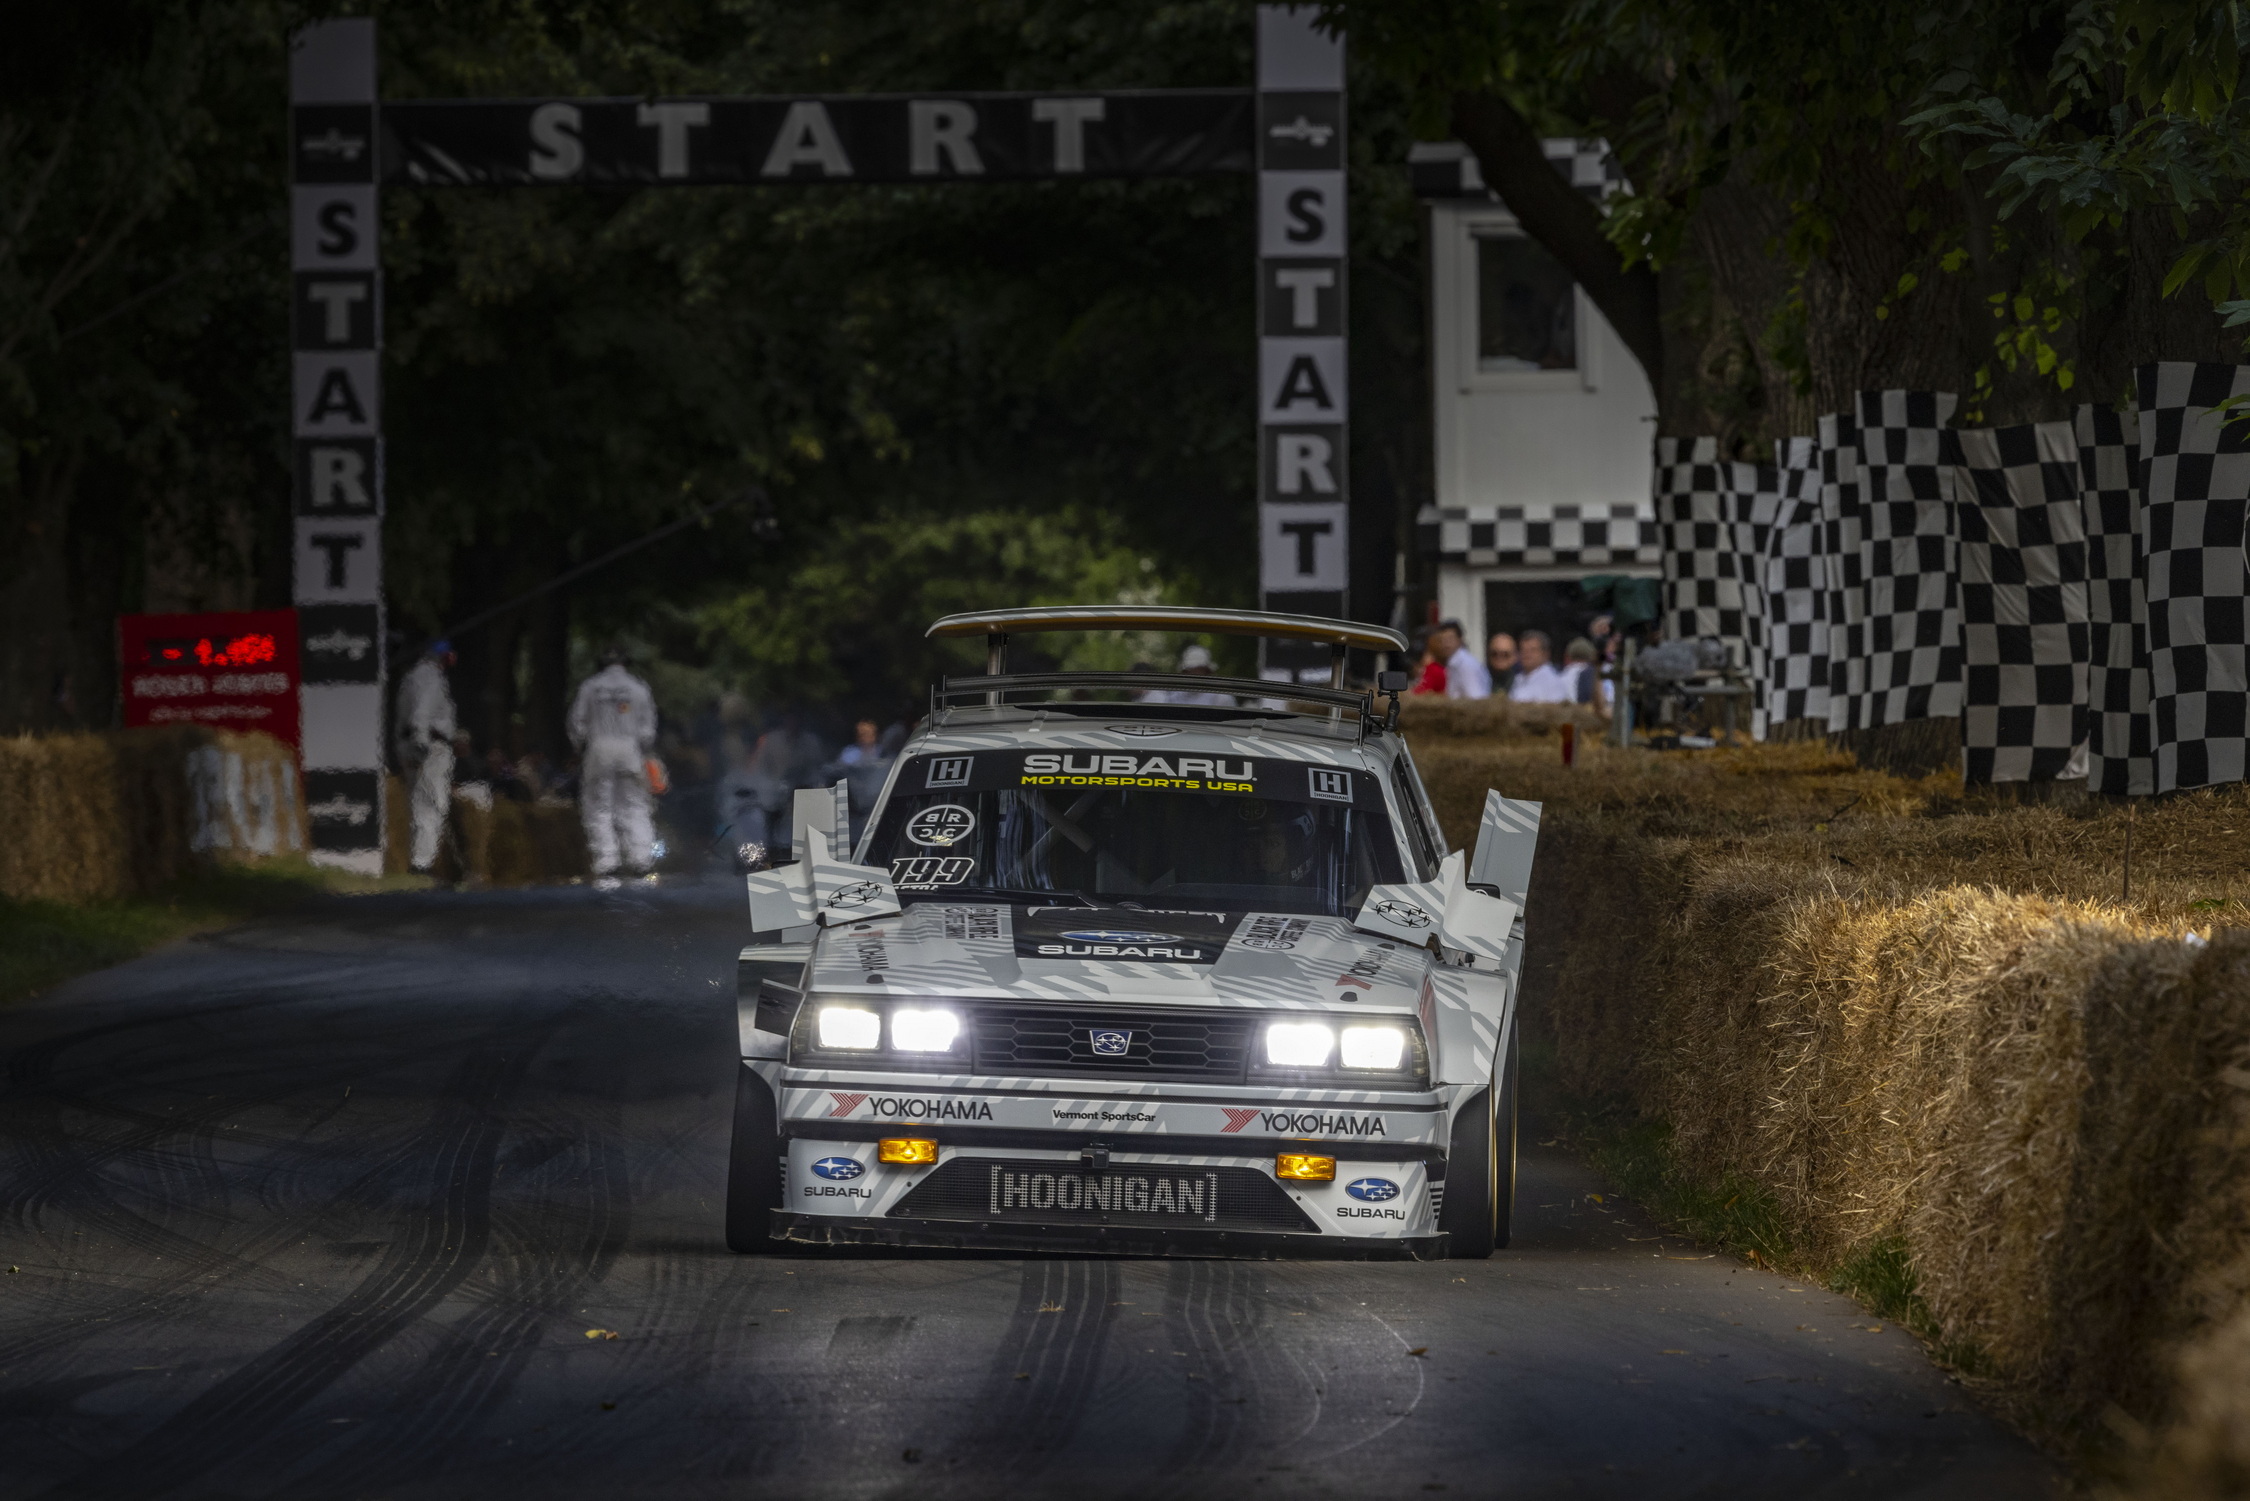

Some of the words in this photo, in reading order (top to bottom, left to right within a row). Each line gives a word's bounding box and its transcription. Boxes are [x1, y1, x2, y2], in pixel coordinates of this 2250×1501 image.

[528, 98, 1105, 179] START
[1273, 187, 1337, 577] START
[306, 201, 368, 589] START
[1023, 754, 1254, 781] SUBARU
[1021, 776, 1200, 790] MOTORSPORTS
[1207, 780, 1253, 793] USA
[891, 856, 975, 885] 199
[1037, 944, 1201, 960] SUBARU
[869, 1097, 993, 1121] YOKOHAMA
[1053, 1110, 1099, 1120] Vermont
[1101, 1111, 1156, 1123] SportsCar
[1260, 1112, 1386, 1136] YOKOHAMA
[804, 1186, 872, 1198] SUBARU
[1337, 1207, 1405, 1220] SUBARU
